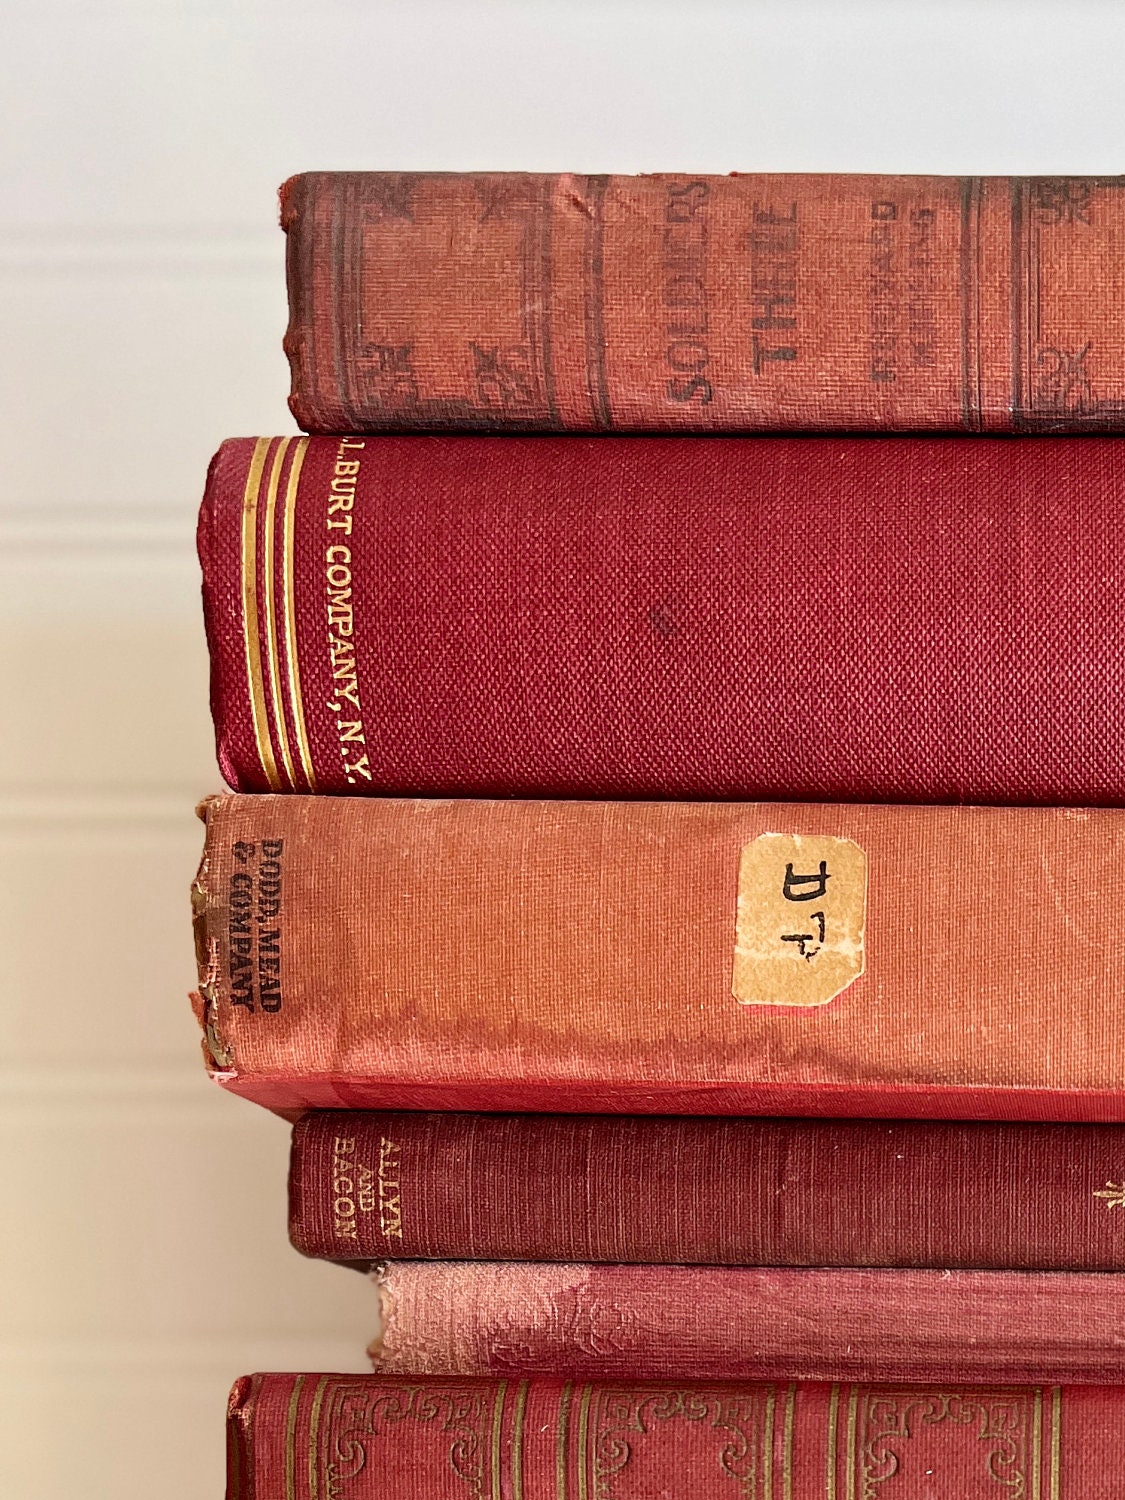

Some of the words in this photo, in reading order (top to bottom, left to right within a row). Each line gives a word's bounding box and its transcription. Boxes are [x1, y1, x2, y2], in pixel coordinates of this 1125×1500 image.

[326, 545, 361, 712] COMPANY,
[232, 841, 256, 864] &
[255, 839, 284, 924] DODD,
[229, 873, 254, 1014] COMPANY
[258, 928, 282, 1014] MEAD
[334, 1136, 358, 1239] BACON
[358, 1164, 375, 1212] AND
[379, 1137, 403, 1239] ALLYN
